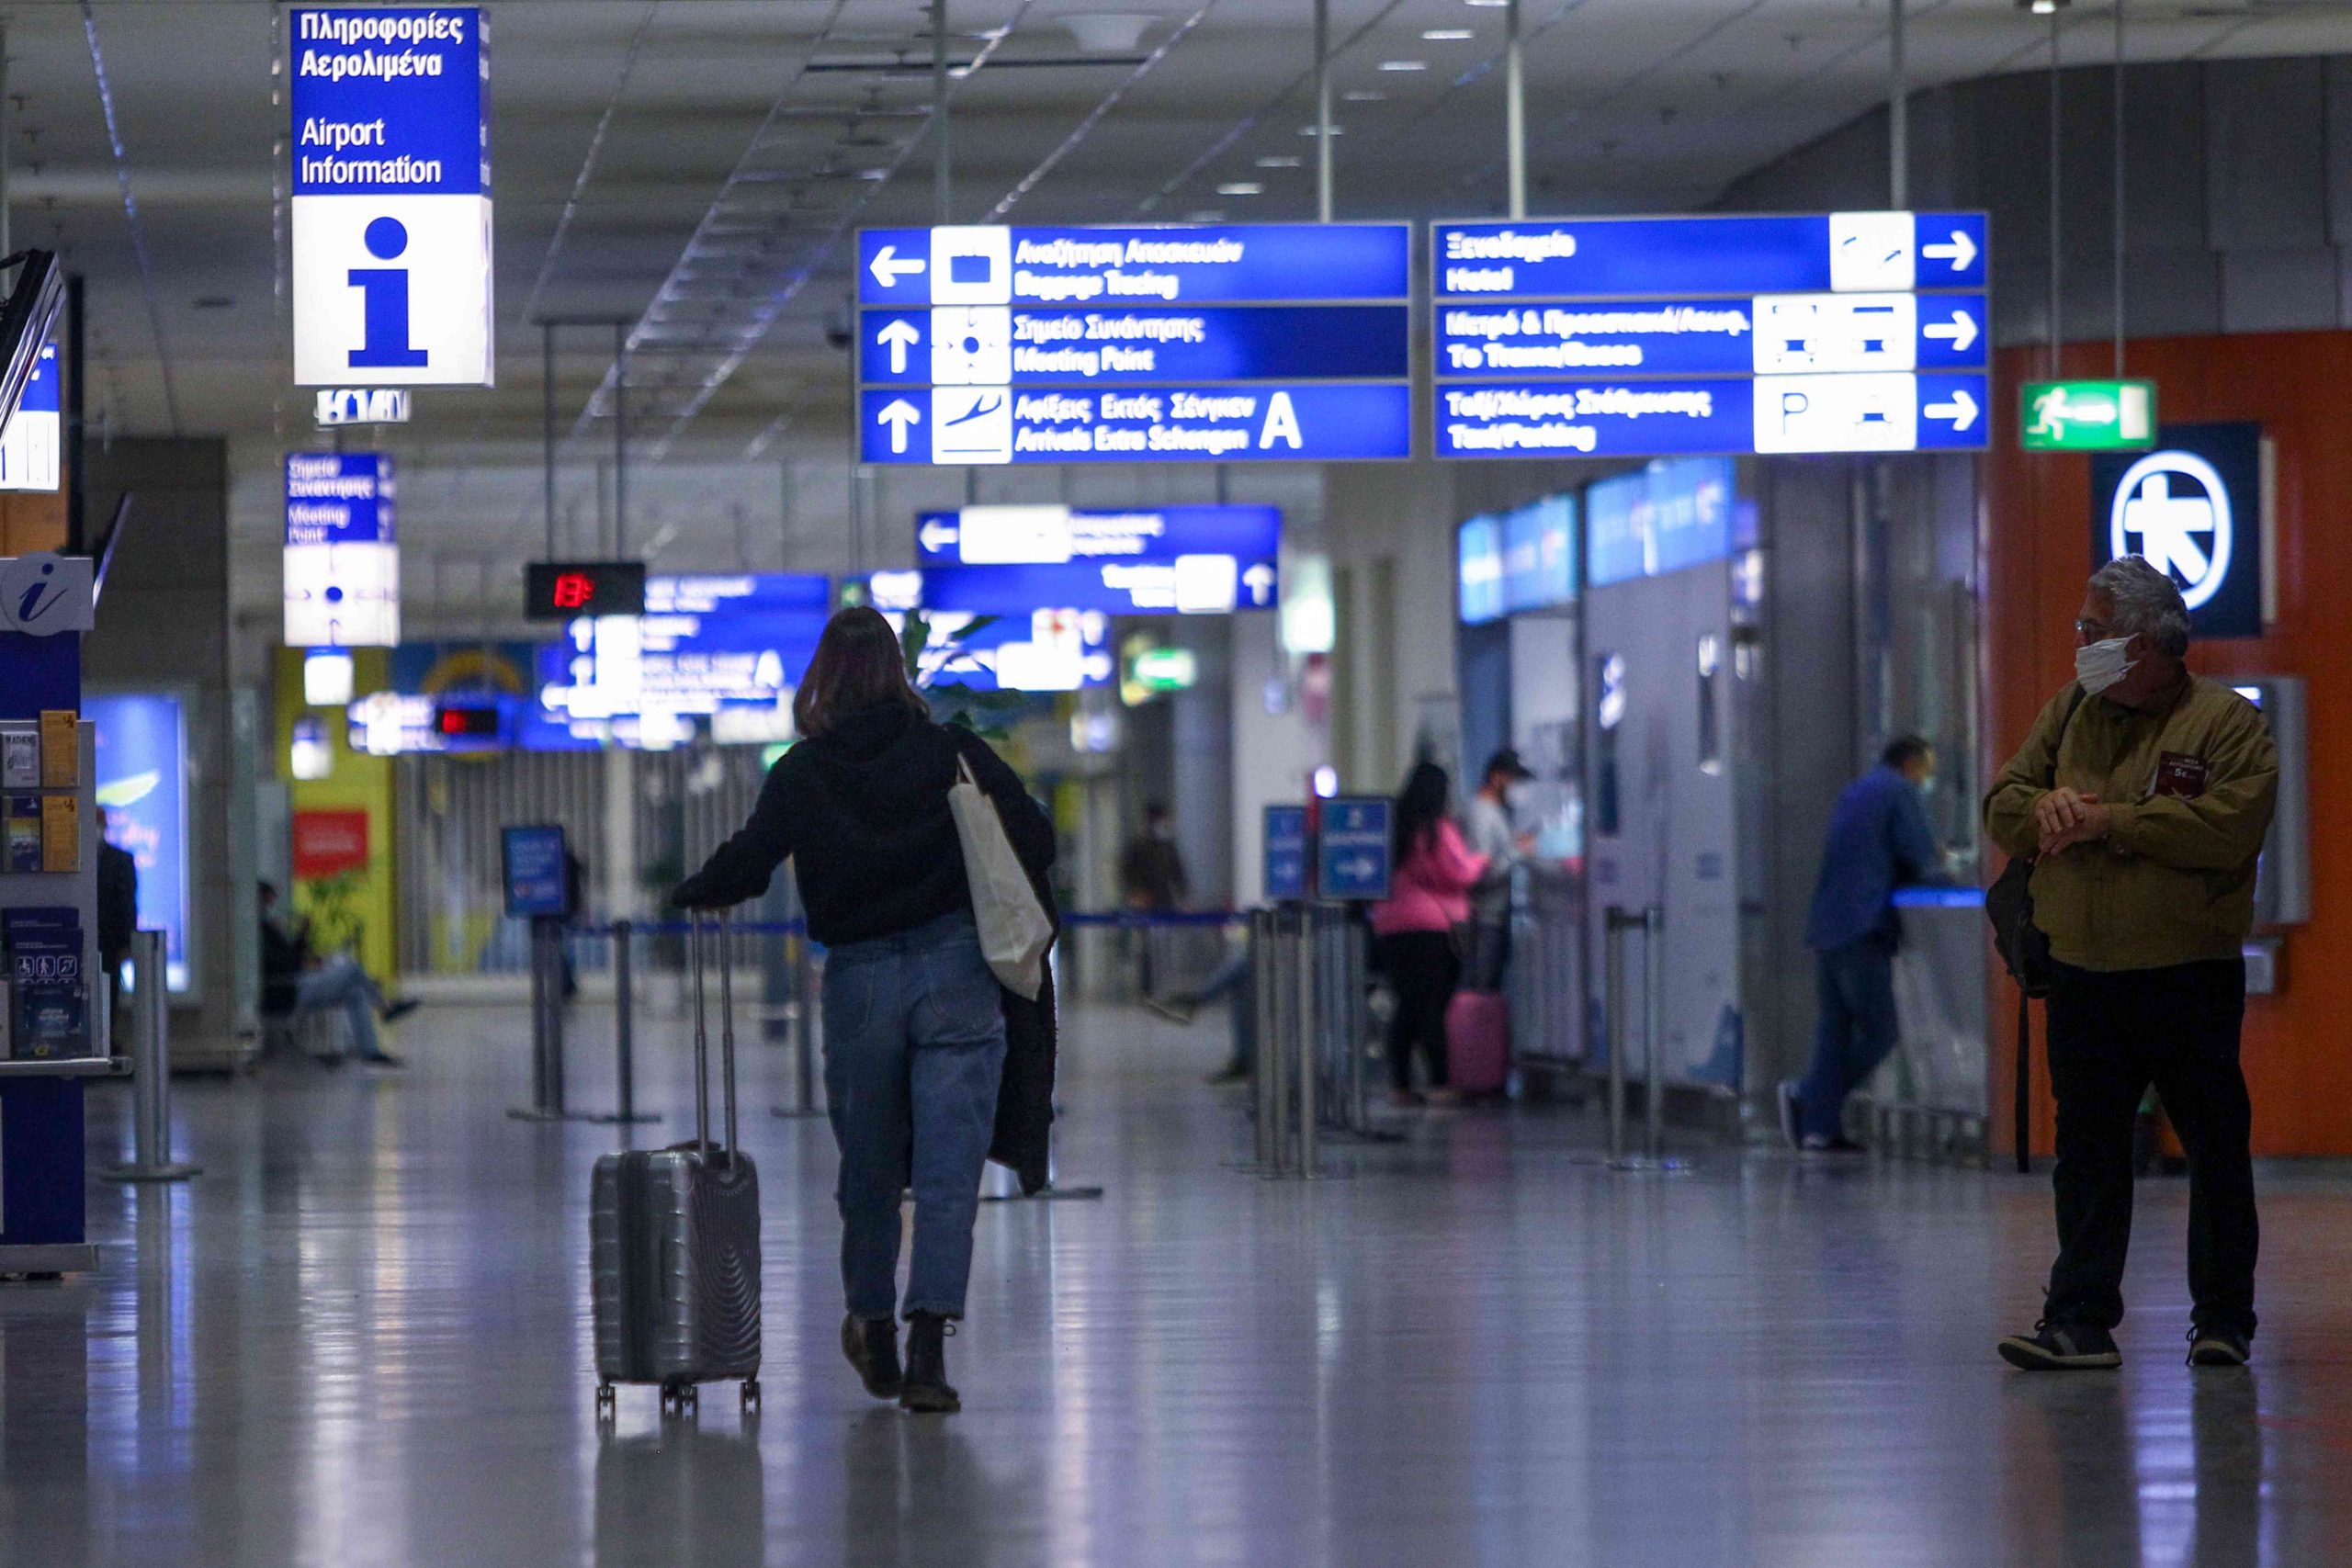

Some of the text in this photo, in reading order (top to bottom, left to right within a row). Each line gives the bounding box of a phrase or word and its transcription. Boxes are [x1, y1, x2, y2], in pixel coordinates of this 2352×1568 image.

[300, 12, 464, 45] Πληροφορίες
[300, 49, 443, 82] Αερολιμένα
[300, 118, 386, 152] Airport
[301, 154, 442, 184] Information
[1013, 314, 1205, 344] Σημείο Συνάντησης
[1013, 345, 1156, 377] Meeting Point
[1014, 393, 1093, 423] Αφίξεις
[1101, 393, 1163, 423] Εκτός
[1259, 391, 1303, 449] A
[1014, 425, 1093, 452] Arrivals
[1093, 424, 1148, 452] Extra
